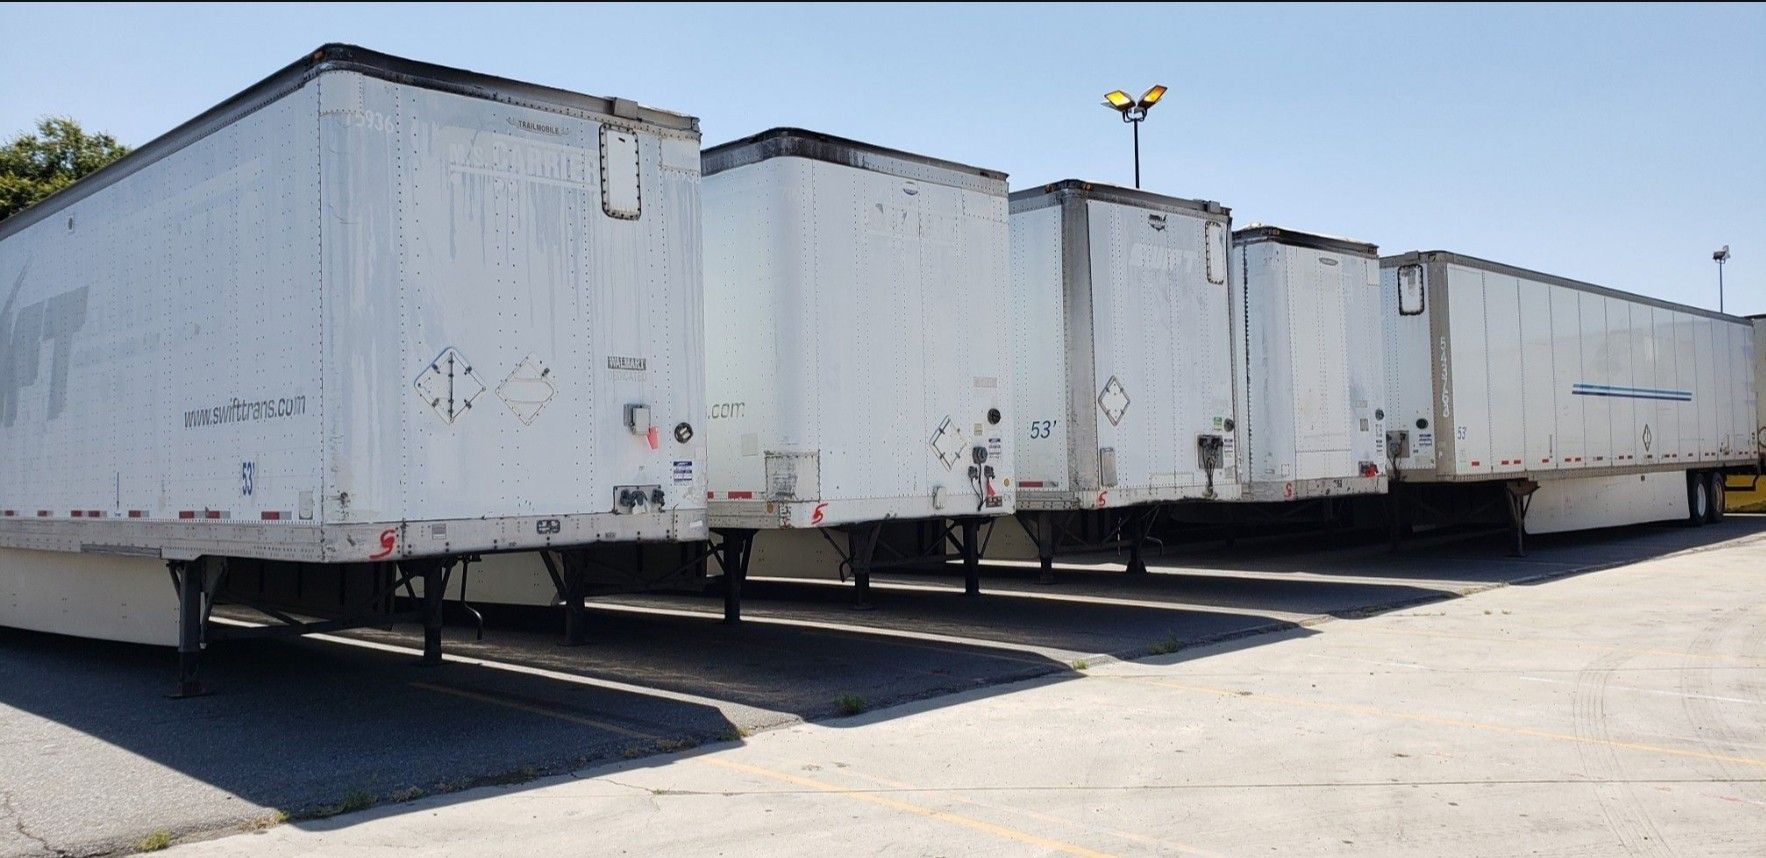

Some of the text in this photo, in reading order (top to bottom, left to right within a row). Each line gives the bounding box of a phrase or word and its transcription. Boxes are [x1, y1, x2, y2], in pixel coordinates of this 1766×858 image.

[518, 120, 560, 135] TRAILMOBILE
[607, 356, 646, 370] WALMART
[184, 395, 306, 428] www.swifttrans.com
[1030, 420, 1057, 440] 53'
[242, 461, 255, 496] 53'
